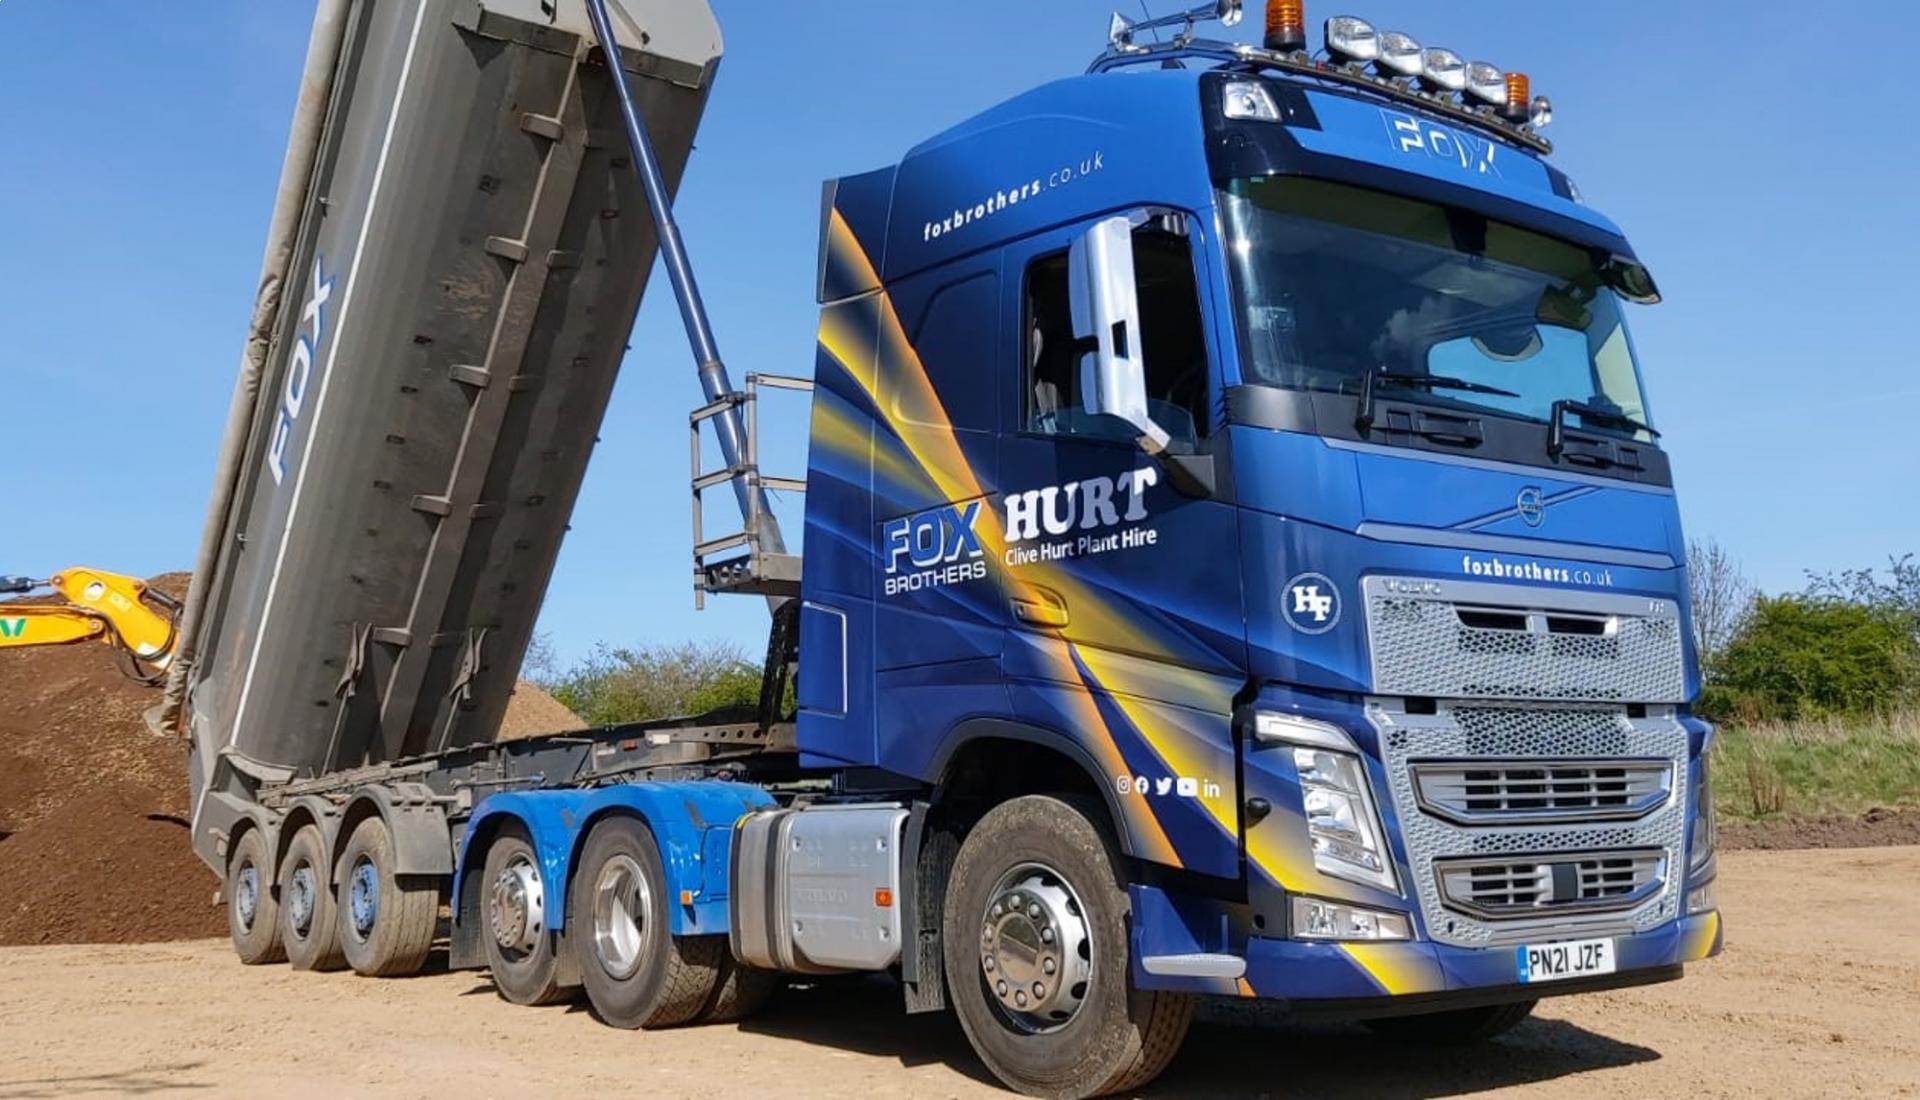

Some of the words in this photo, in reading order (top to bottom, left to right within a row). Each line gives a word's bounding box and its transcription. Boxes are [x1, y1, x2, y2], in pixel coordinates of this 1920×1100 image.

[1379, 107, 1504, 181] FOX
[923, 151, 1104, 242] foxbrothers.co.uk
[267, 255, 336, 486] FOX
[882, 500, 985, 574] FOX
[1004, 466, 1158, 543] HURT
[885, 560, 987, 596] BROTHERS
[1005, 546, 1038, 567] Clive
[1040, 541, 1074, 561] Hurt
[1078, 534, 1119, 555] Plant
[1121, 526, 1158, 549] Hire
[1462, 555, 1614, 588] foxbrothers.co.uk
[1530, 947, 1570, 976] PN21
[1574, 943, 1604, 971] JZF
